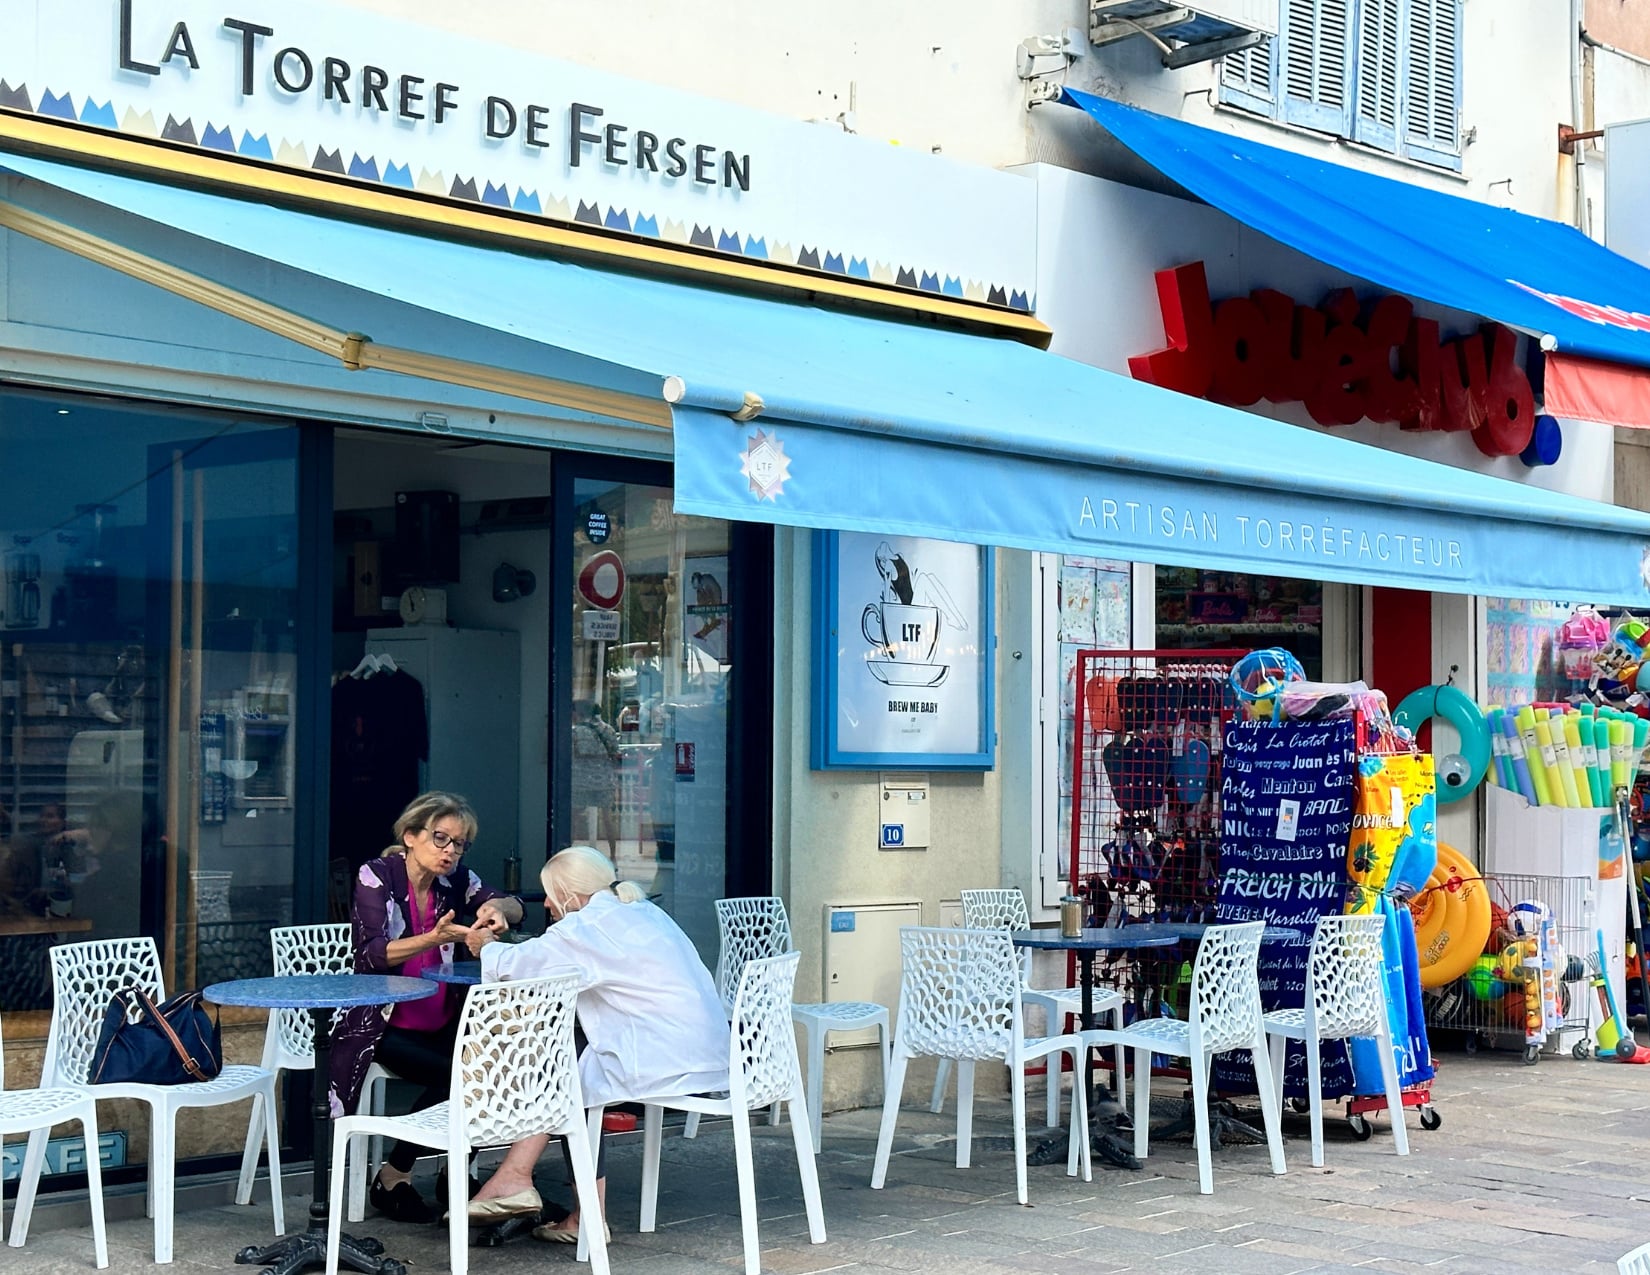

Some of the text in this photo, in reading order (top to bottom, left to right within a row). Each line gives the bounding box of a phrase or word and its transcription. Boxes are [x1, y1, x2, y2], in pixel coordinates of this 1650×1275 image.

[119, 0, 751, 193] LA TORREF DE FERSEN
[756, 463, 773, 471] LTF
[588, 521, 607, 529] COFFEE
[1079, 496, 1464, 568] ARTISAN TORRÉFACTEUR
[902, 623, 921, 642] LTF
[888, 700, 938, 714] BREW ME BABY
[1292, 754, 1323, 770] Juan
[887, 828, 900, 842] 10
